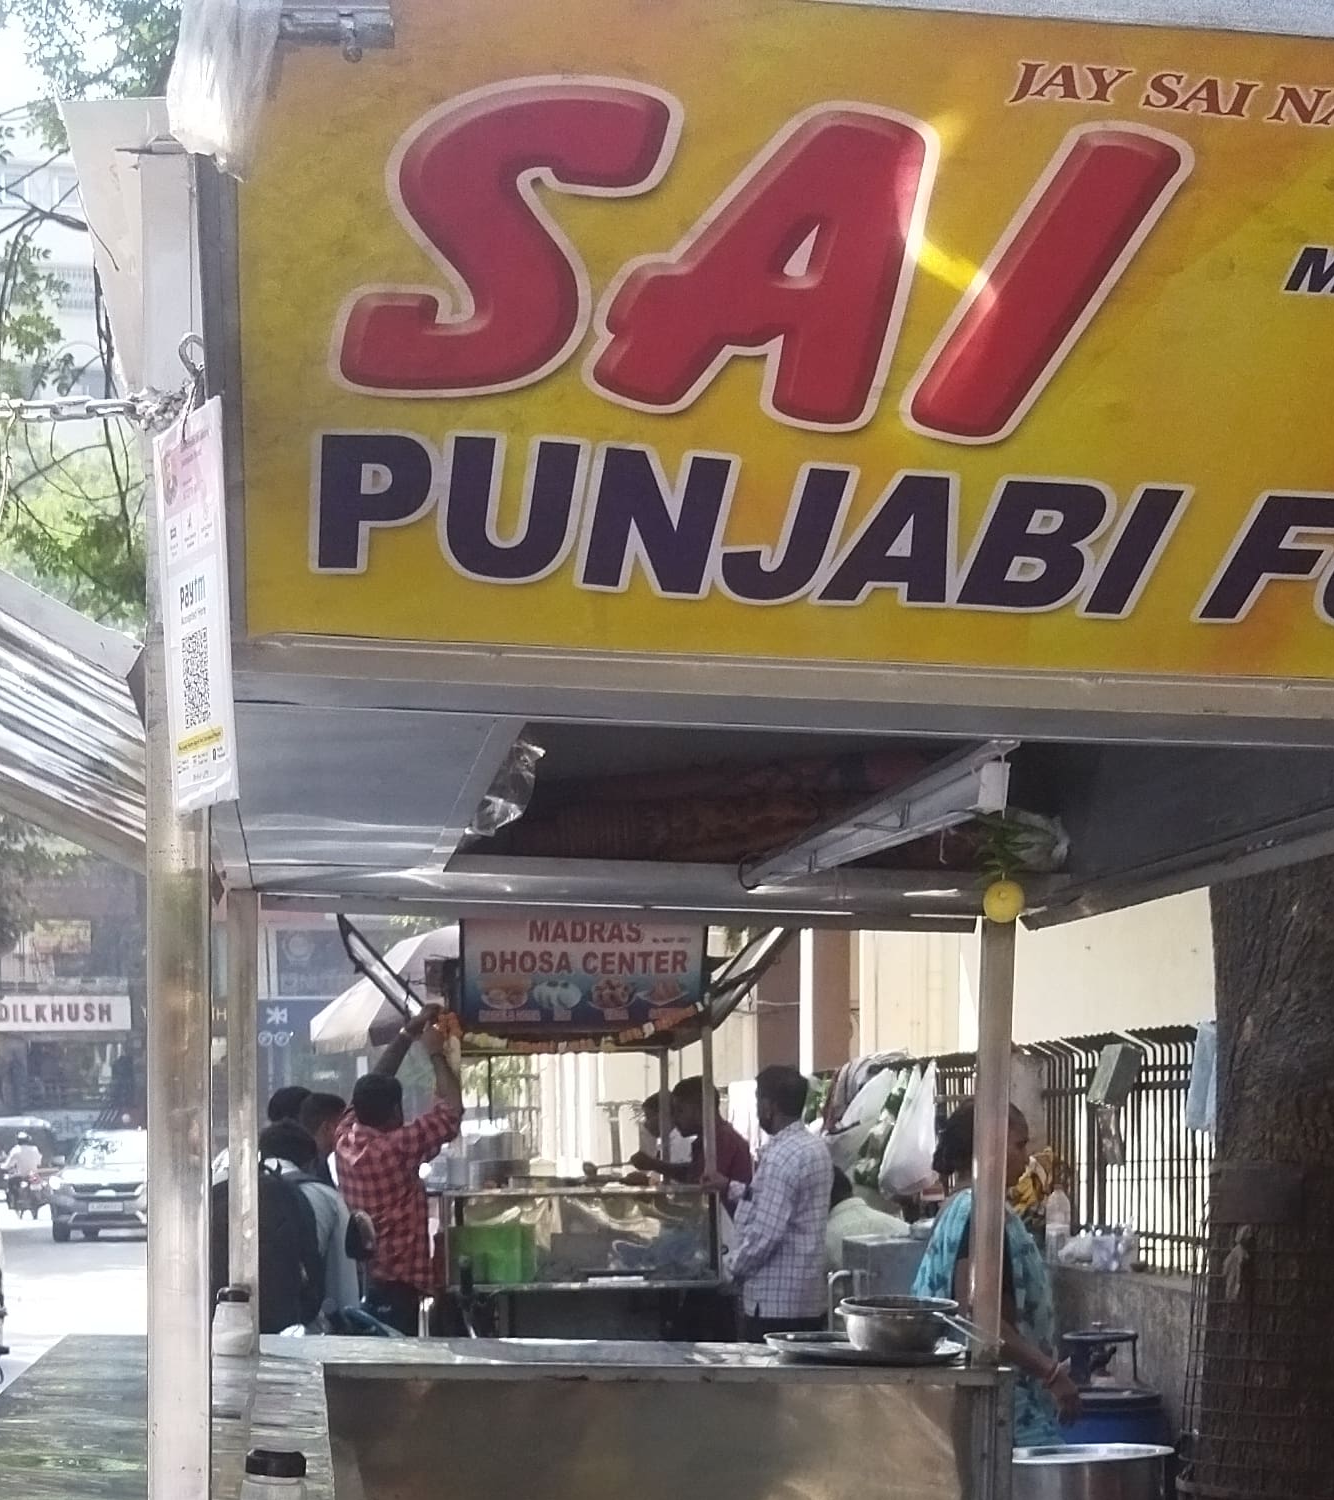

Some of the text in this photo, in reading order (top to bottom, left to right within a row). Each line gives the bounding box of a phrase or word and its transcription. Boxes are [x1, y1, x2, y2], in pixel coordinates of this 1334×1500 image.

[1008, 61, 1133, 104] JAY
[1142, 73, 1259, 118] SAI
[332, 78, 1189, 442] SAI
[312, 431, 1191, 619] PUNJABI
[528, 919, 643, 944] MADRAS
[479, 950, 689, 976] DHOSA CENTER
